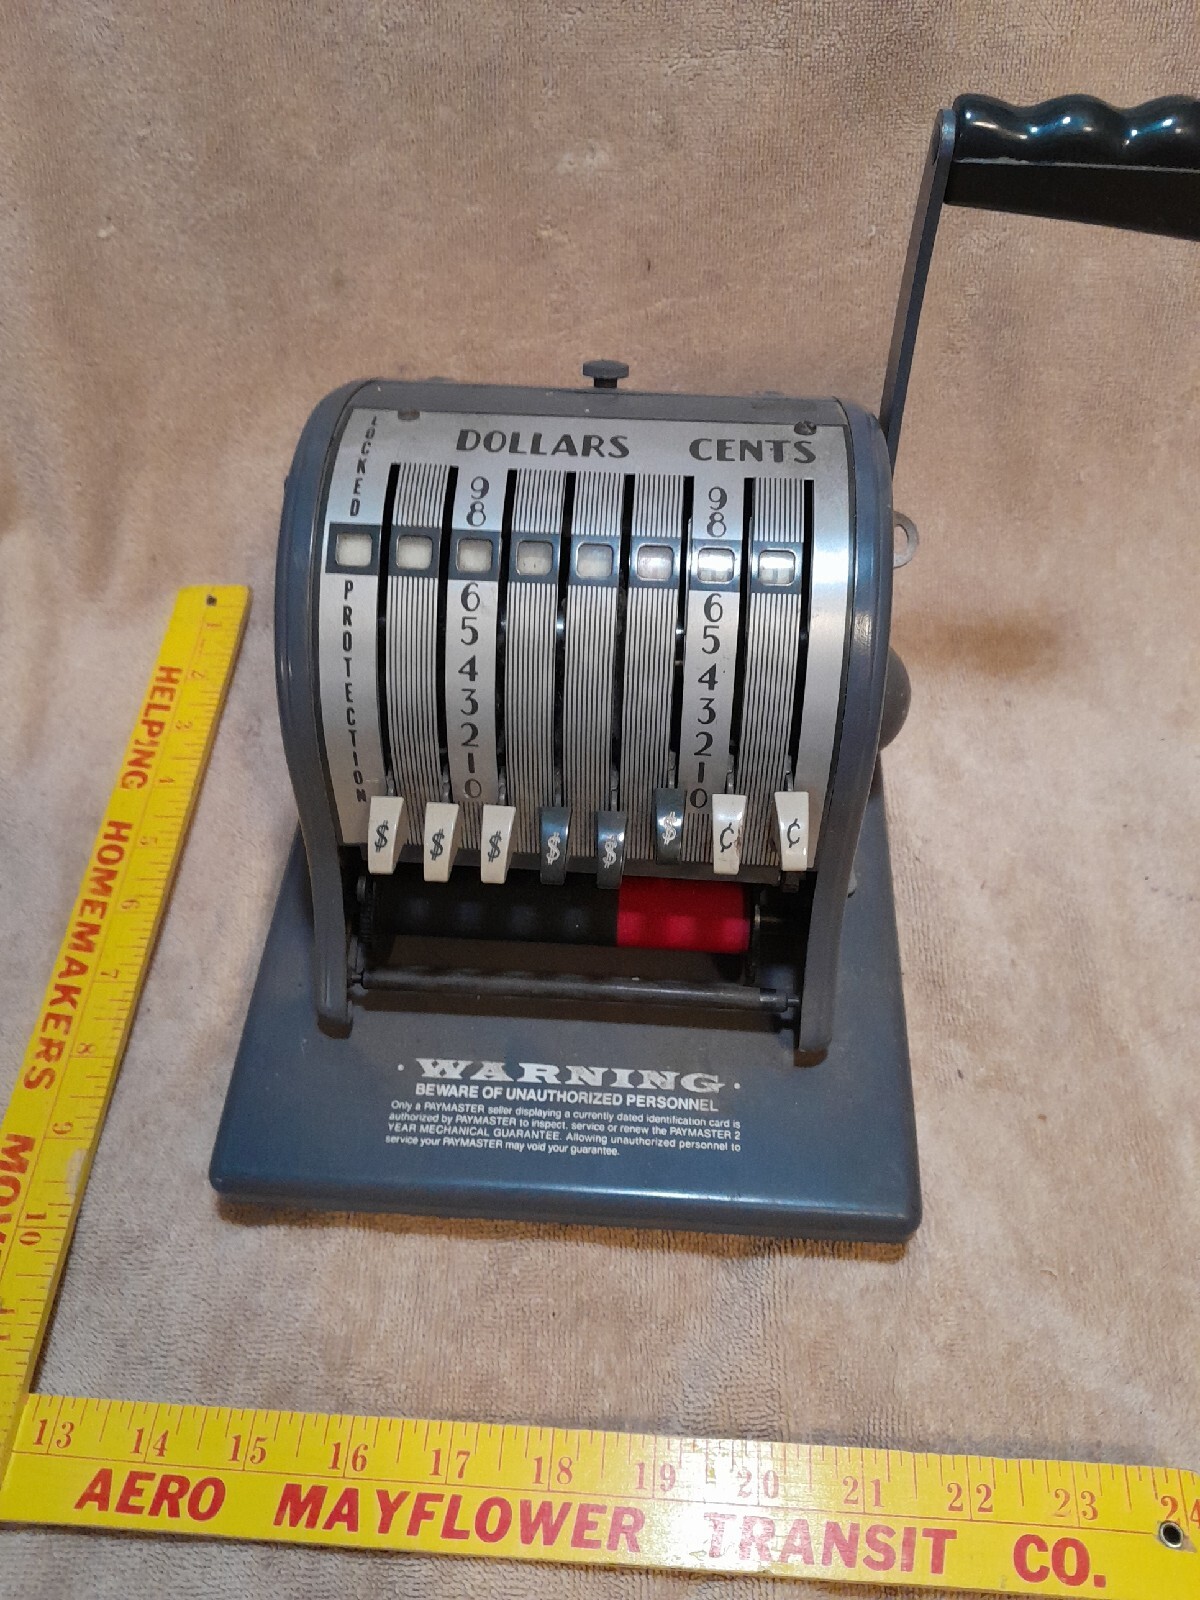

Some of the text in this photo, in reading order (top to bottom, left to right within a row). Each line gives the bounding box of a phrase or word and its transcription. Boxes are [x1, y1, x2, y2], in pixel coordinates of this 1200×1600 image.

[456, 428, 817, 464] DOLLARS CENTS
[470, 476, 490, 500] 9
[707, 486, 728, 510] 9
[466, 501, 487, 527] 8
[706, 511, 727, 538] 8
[460, 582, 480, 612] 6
[704, 592, 723, 622] 6
[461, 616, 478, 646] 5
[702, 625, 720, 654] 5
[458, 655, 478, 682] 4
[698, 663, 718, 691] 4
[460, 689, 478, 716] 3
[697, 698, 716, 725] 3
[120, 665, 183, 790] HELPING
[460, 722, 478, 747] 2
[694, 732, 713, 757] 2
[464, 778, 482, 798] 0
[689, 788, 708, 808] 0
[120, 899, 140, 910] 6
[23, 819, 133, 1090] HOMEMAKERS
[101, 969, 119, 979] 7
[77, 1043, 96, 1055] 8
[415, 1057, 725, 1094] WARNING
[416, 1083, 719, 1112] BEWARE OF UNAUTHORIZED PERSONNEL
[389, 1112, 439, 1123] authorized
[442, 1113, 452, 1124] by
[455, 1115, 516, 1127] PAYMASTER
[520, 1119, 529, 1127] to
[571, 1122, 605, 1132] service
[607, 1124, 618, 1132] or
[620, 1126, 649, 1134] renew
[652, 1126, 667, 1135] the
[670, 1127, 731, 1140] PAYMASTER
[734, 1132, 740, 1140] 2
[391, 1100, 412, 1111] Only
[424, 1101, 484, 1113] PAYMASTER
[516, 1104, 561, 1118] displaying
[573, 1111, 613, 1122] currently
[617, 1112, 643, 1122] dated
[647, 1114, 707, 1126] identification
[709, 1119, 730, 1128] card
[733, 1120, 740, 1129] is
[52, 1122, 73, 1135] 9
[388, 1123, 740, 1151] YEAR MECHANICAL GUARANTEE. Allowing unauthorized personnel to
[385, 1135, 620, 1156] service your PAYMASTER may void your guarantee.
[18, 1211, 46, 1246] 10
[32, 1418, 75, 1449] 13
[129, 1427, 169, 1458] 14
[227, 1435, 268, 1466] 15
[327, 1442, 368, 1472] 16
[429, 1449, 471, 1479] 17
[531, 1456, 573, 1485] 18
[635, 1462, 676, 1491] 19
[738, 1468, 780, 1499] 20
[842, 1476, 882, 1508] 21
[947, 1483, 994, 1513] 22
[1055, 1489, 1098, 1521] 23
[74, 1467, 1106, 1588] AERO MAYFLOWER TRANSIT CO.
